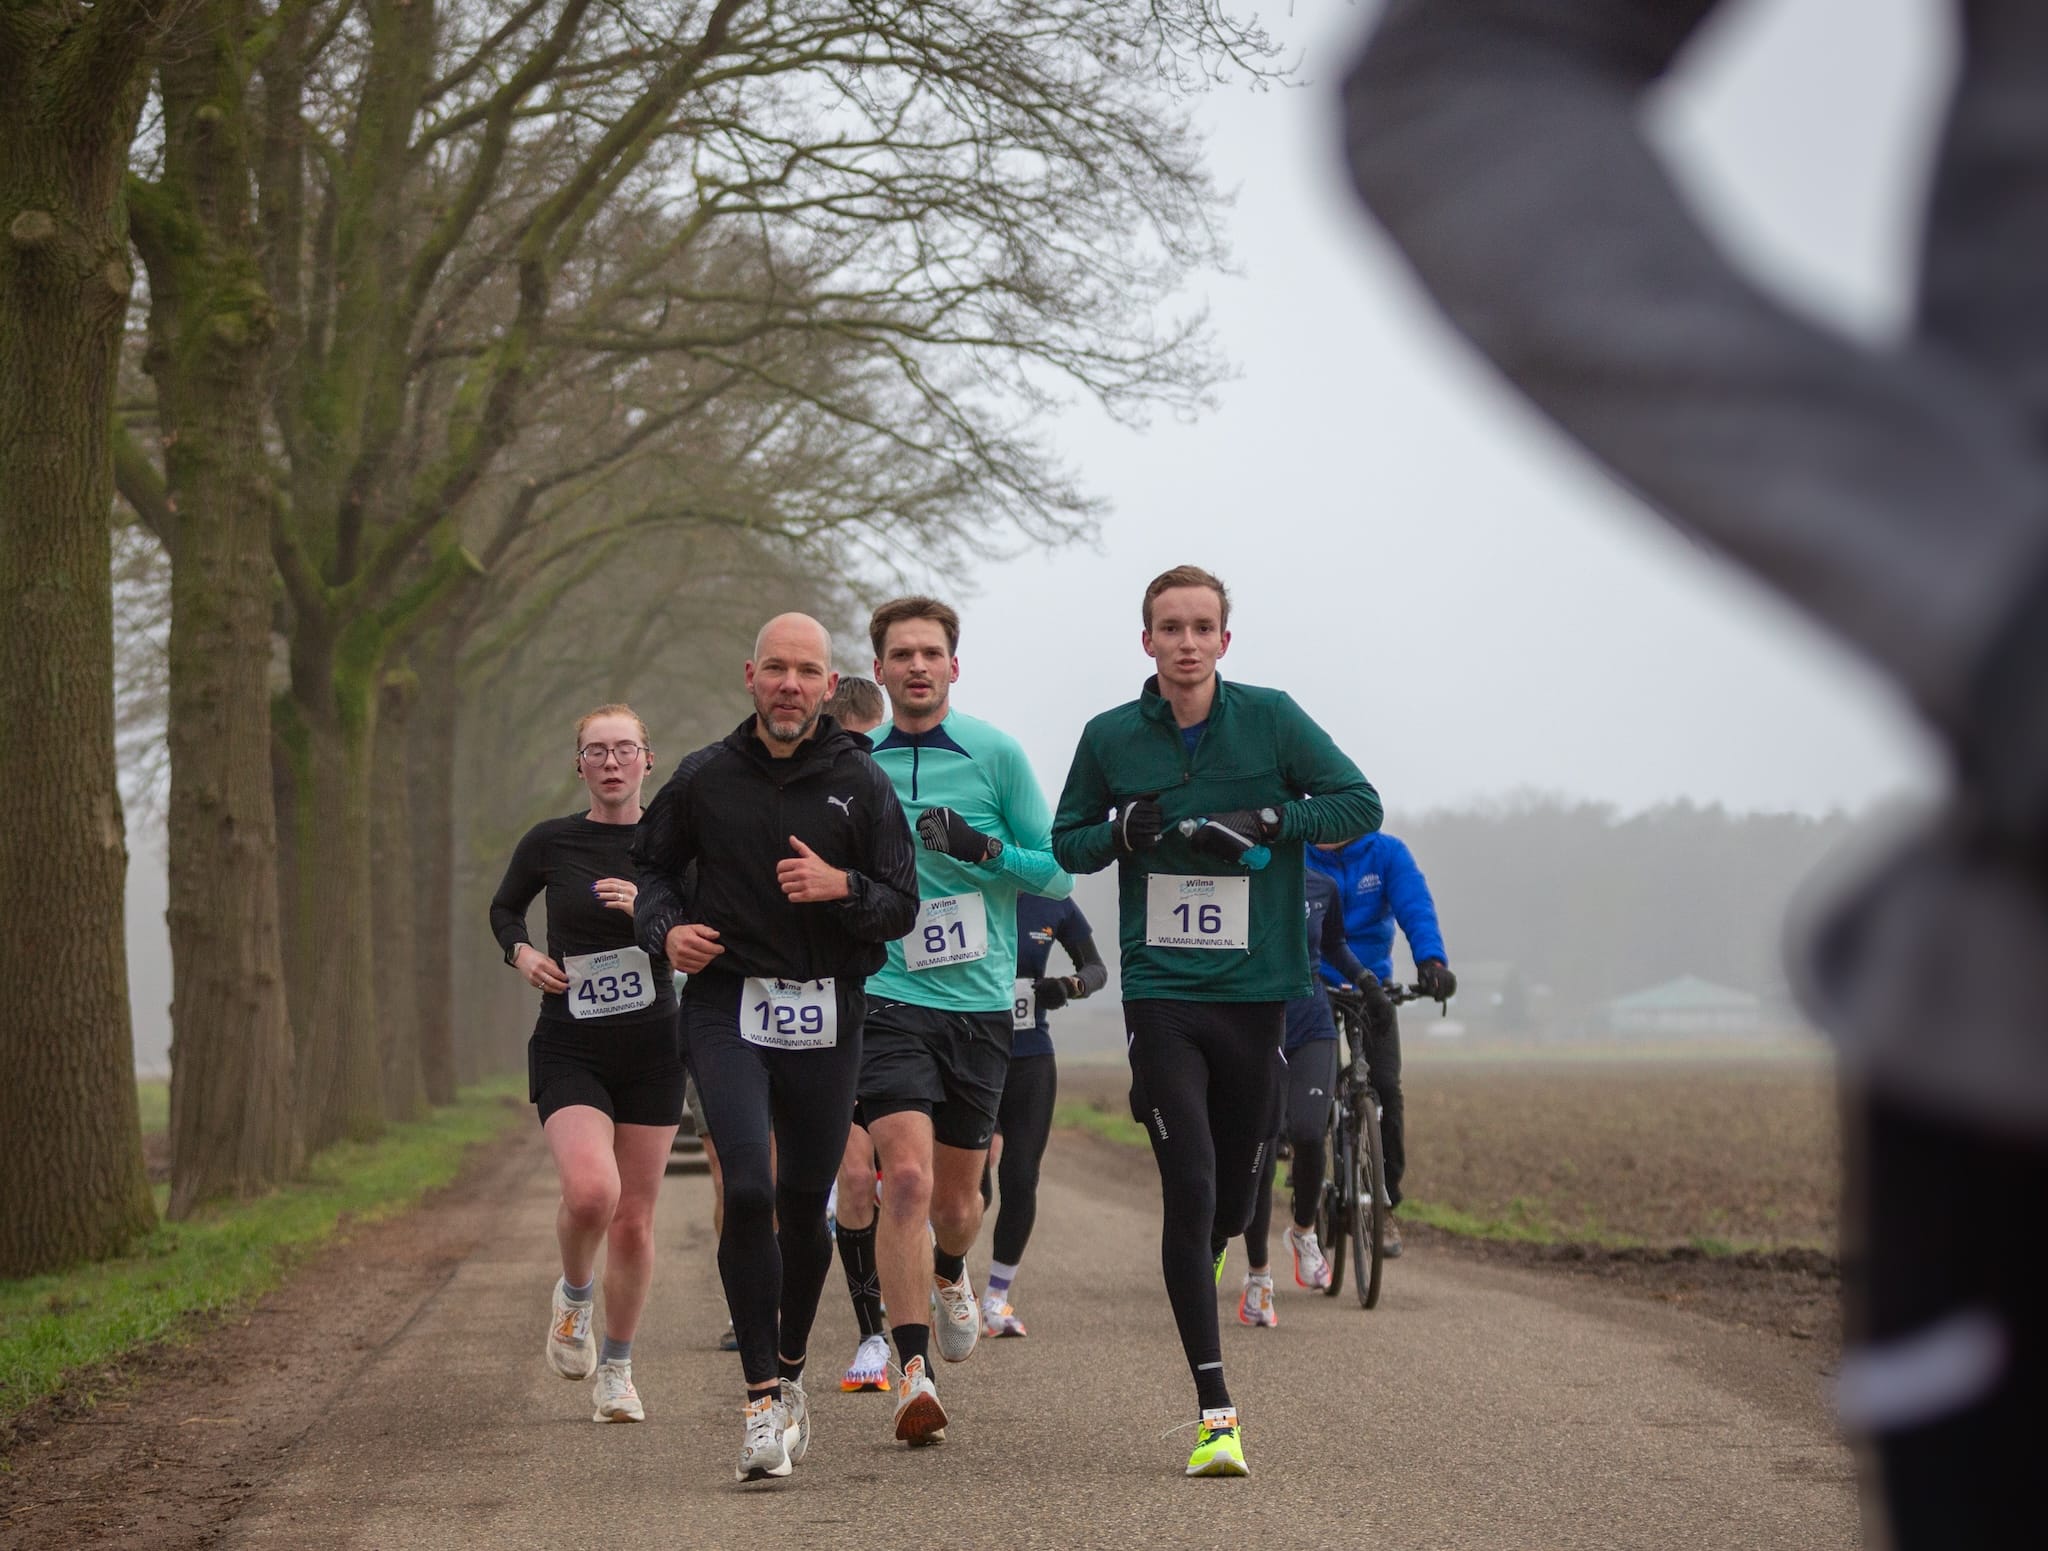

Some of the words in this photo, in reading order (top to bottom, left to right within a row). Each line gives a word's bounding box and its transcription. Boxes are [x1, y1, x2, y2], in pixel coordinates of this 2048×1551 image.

[1186, 879, 1214, 887] Wilma
[931, 899, 956, 910] Wilma
[1172, 903, 1222, 934] 16
[923, 921, 966, 953] 81
[1158, 936, 1234, 946] WILMARUNNING.NL
[594, 953, 618, 963] Wilma
[578, 971, 642, 1004] 433
[579, 1000, 646, 1016] WILMARUNNING.NL
[754, 1000, 823, 1034] 129
[750, 1033, 823, 1047] WILMARUNNING.NL
[1152, 1107, 1169, 1140] FUSION
